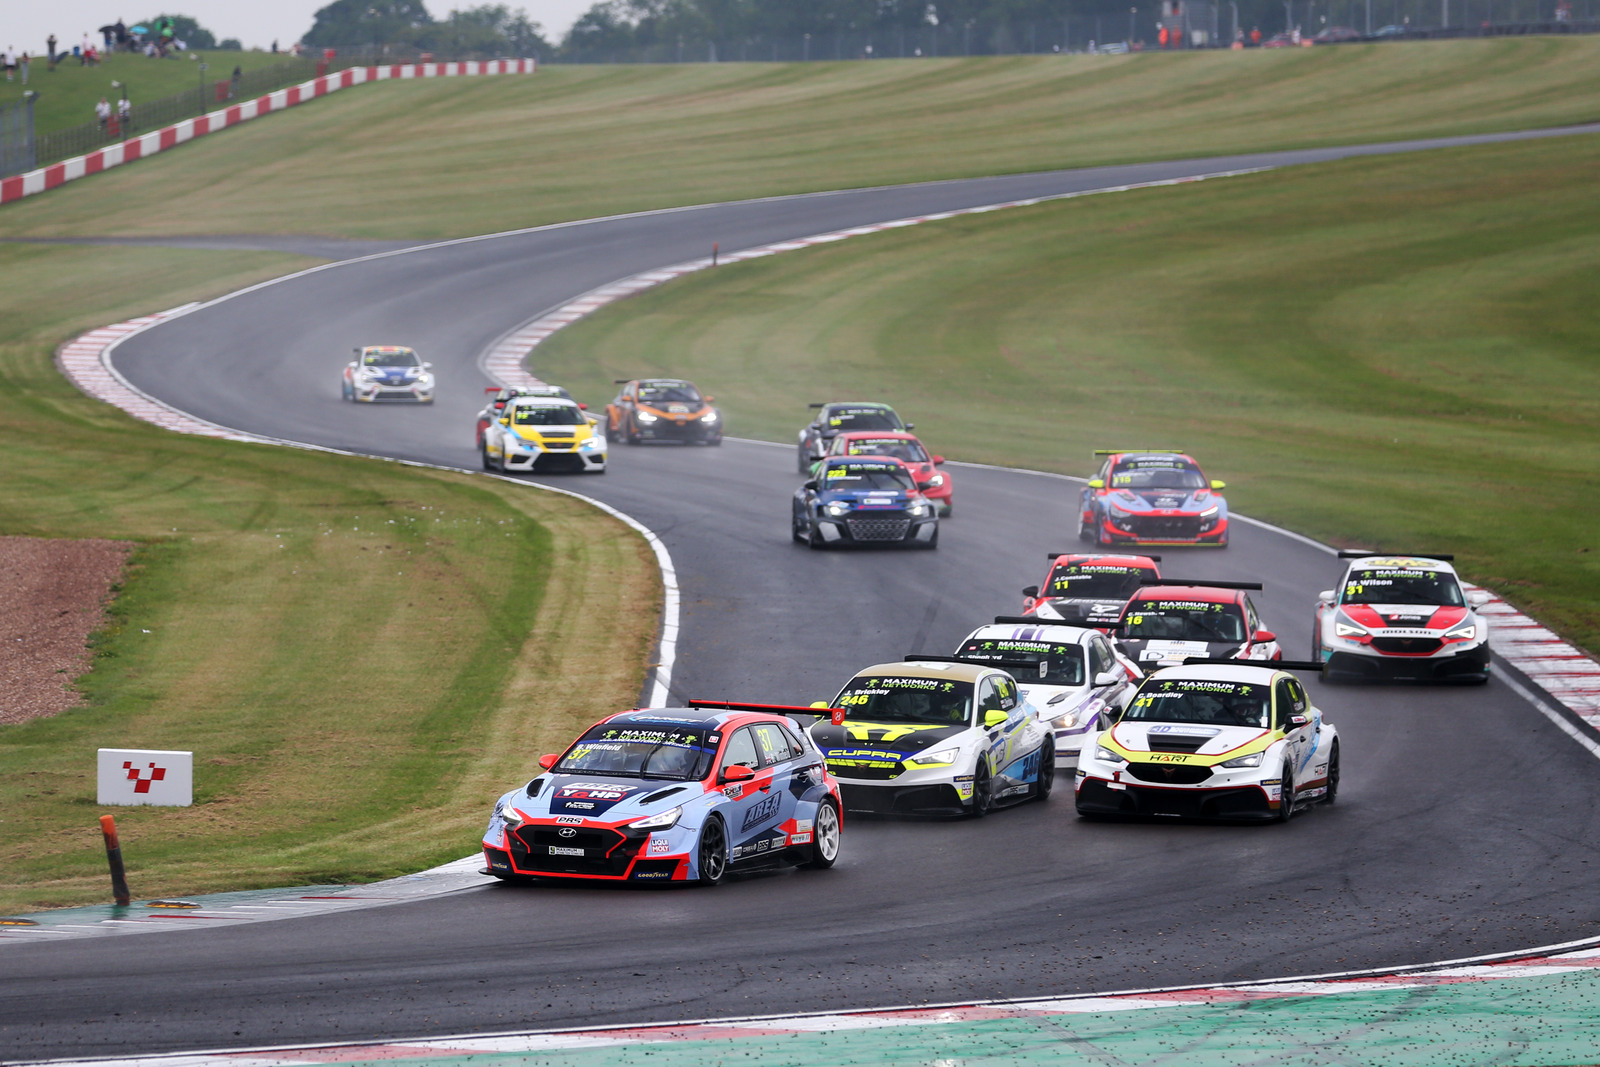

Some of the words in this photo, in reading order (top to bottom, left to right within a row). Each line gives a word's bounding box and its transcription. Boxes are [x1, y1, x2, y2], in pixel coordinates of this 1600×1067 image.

[1054, 580, 1068, 589] 11
[1346, 585, 1362, 595] 31
[1125, 615, 1143, 624] 16
[997, 641, 1051, 649] MAXIMUM
[882, 678, 938, 686] MAXIMUM
[1177, 681, 1235, 689] MAXIMUM
[840, 695, 869, 705] 246
[1134, 697, 1154, 707] 41
[618, 734, 676, 742] NETWORS
[758, 728, 773, 751] 37
[567, 749, 591, 759] 37
[827, 749, 901, 759] CUPRA
[1149, 754, 1191, 763] HART
[558, 816, 581, 824] PRS
